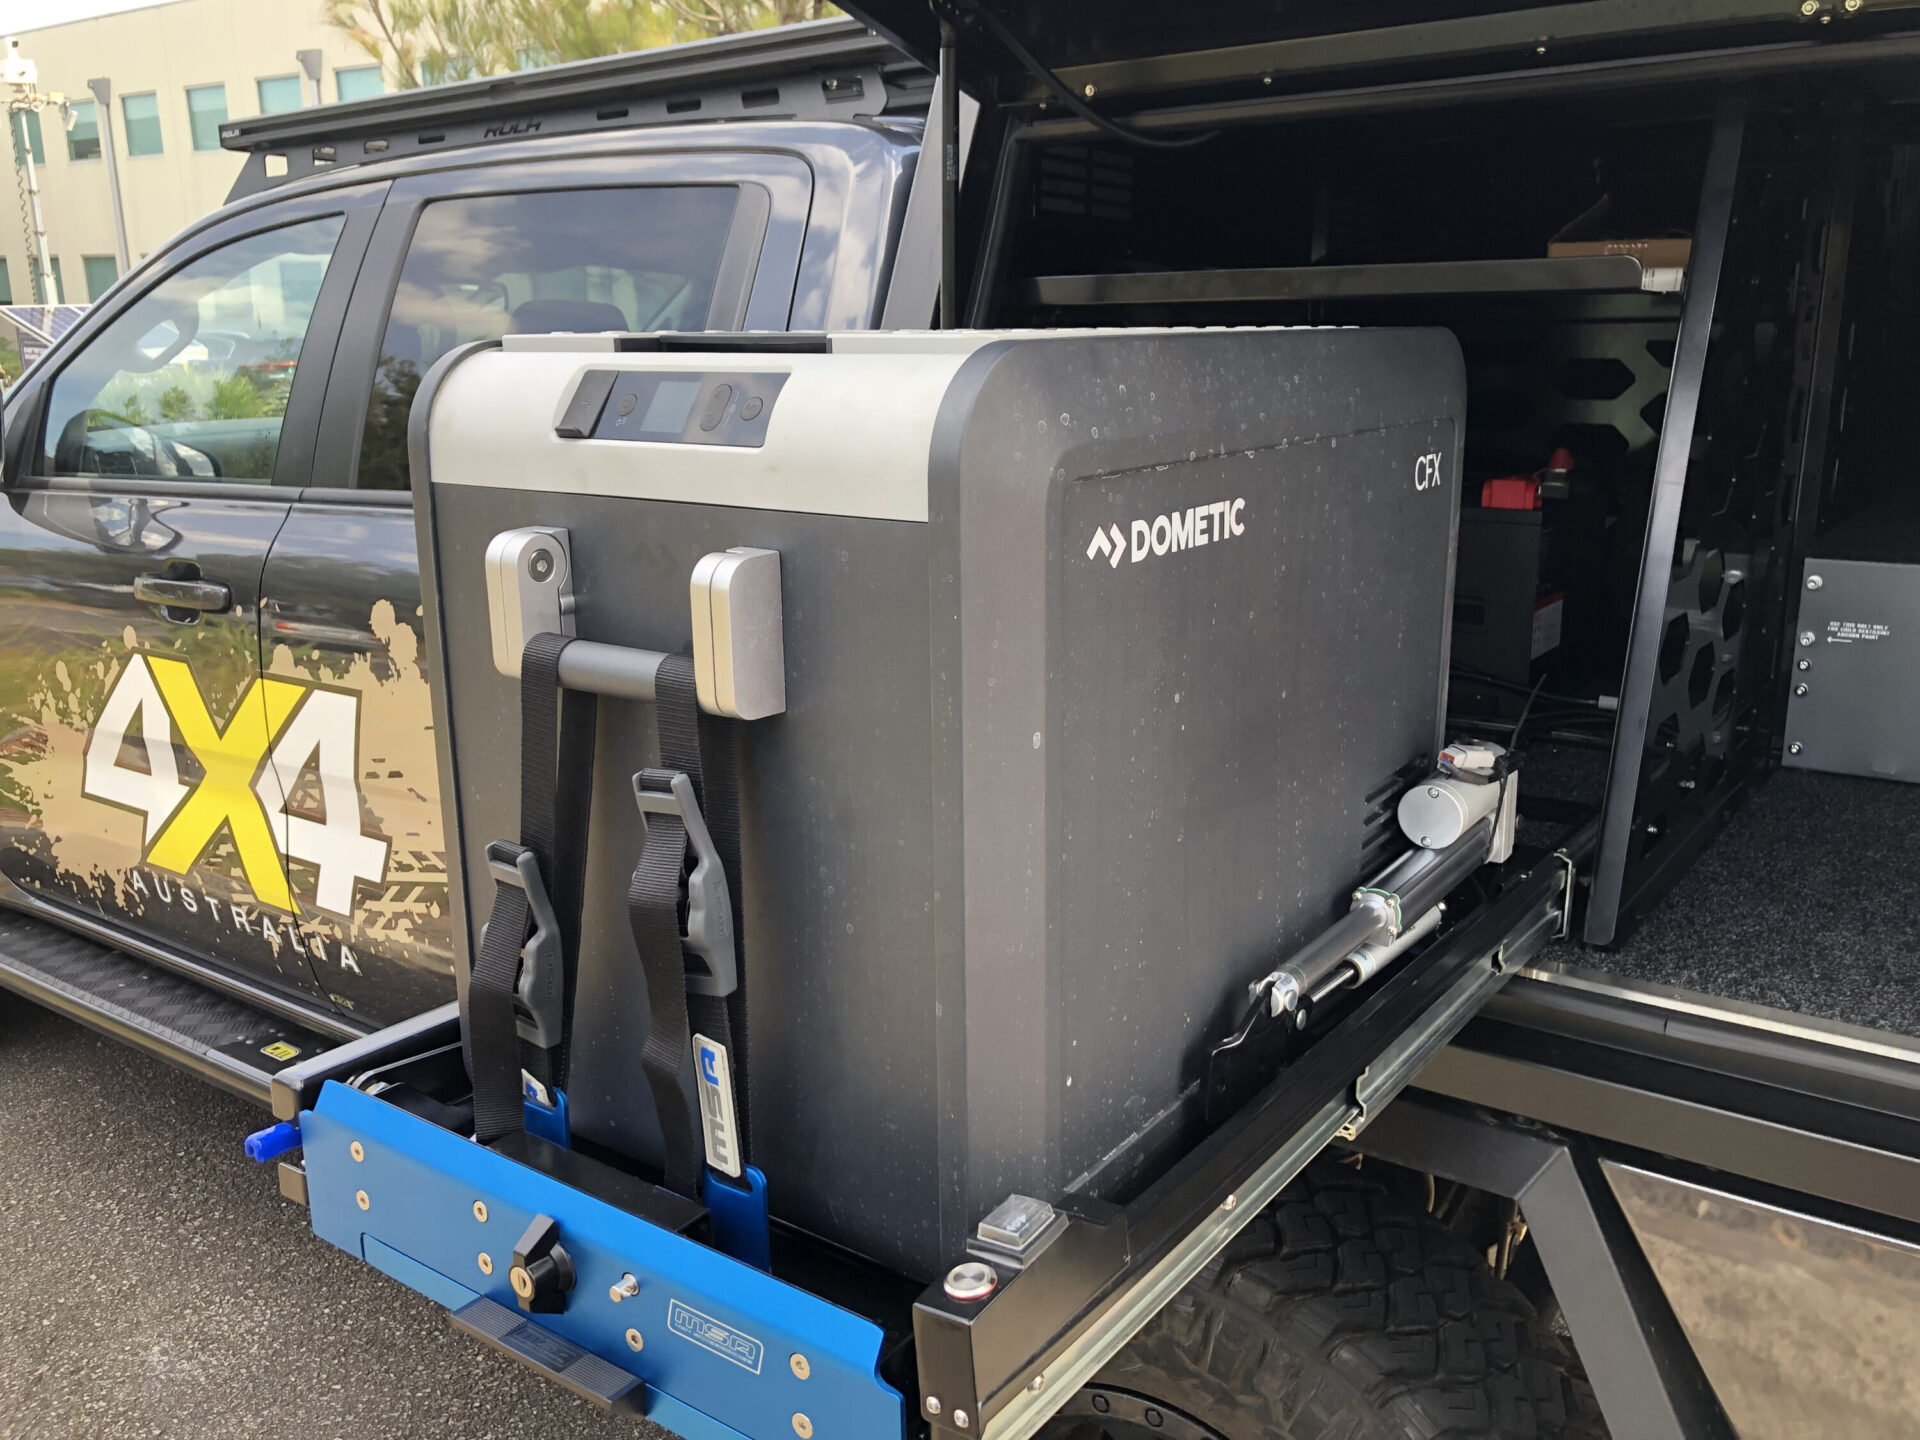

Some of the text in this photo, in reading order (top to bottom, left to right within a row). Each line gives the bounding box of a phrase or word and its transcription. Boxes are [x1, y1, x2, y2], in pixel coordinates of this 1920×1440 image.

[1415, 452, 1442, 491] CFX
[1131, 497, 1246, 563] DOMETIC
[84, 652, 389, 918] 4X4
[131, 870, 363, 976] AUSTRALIA
[701, 1046, 729, 1165] MSA
[675, 1308, 756, 1360] MSA
